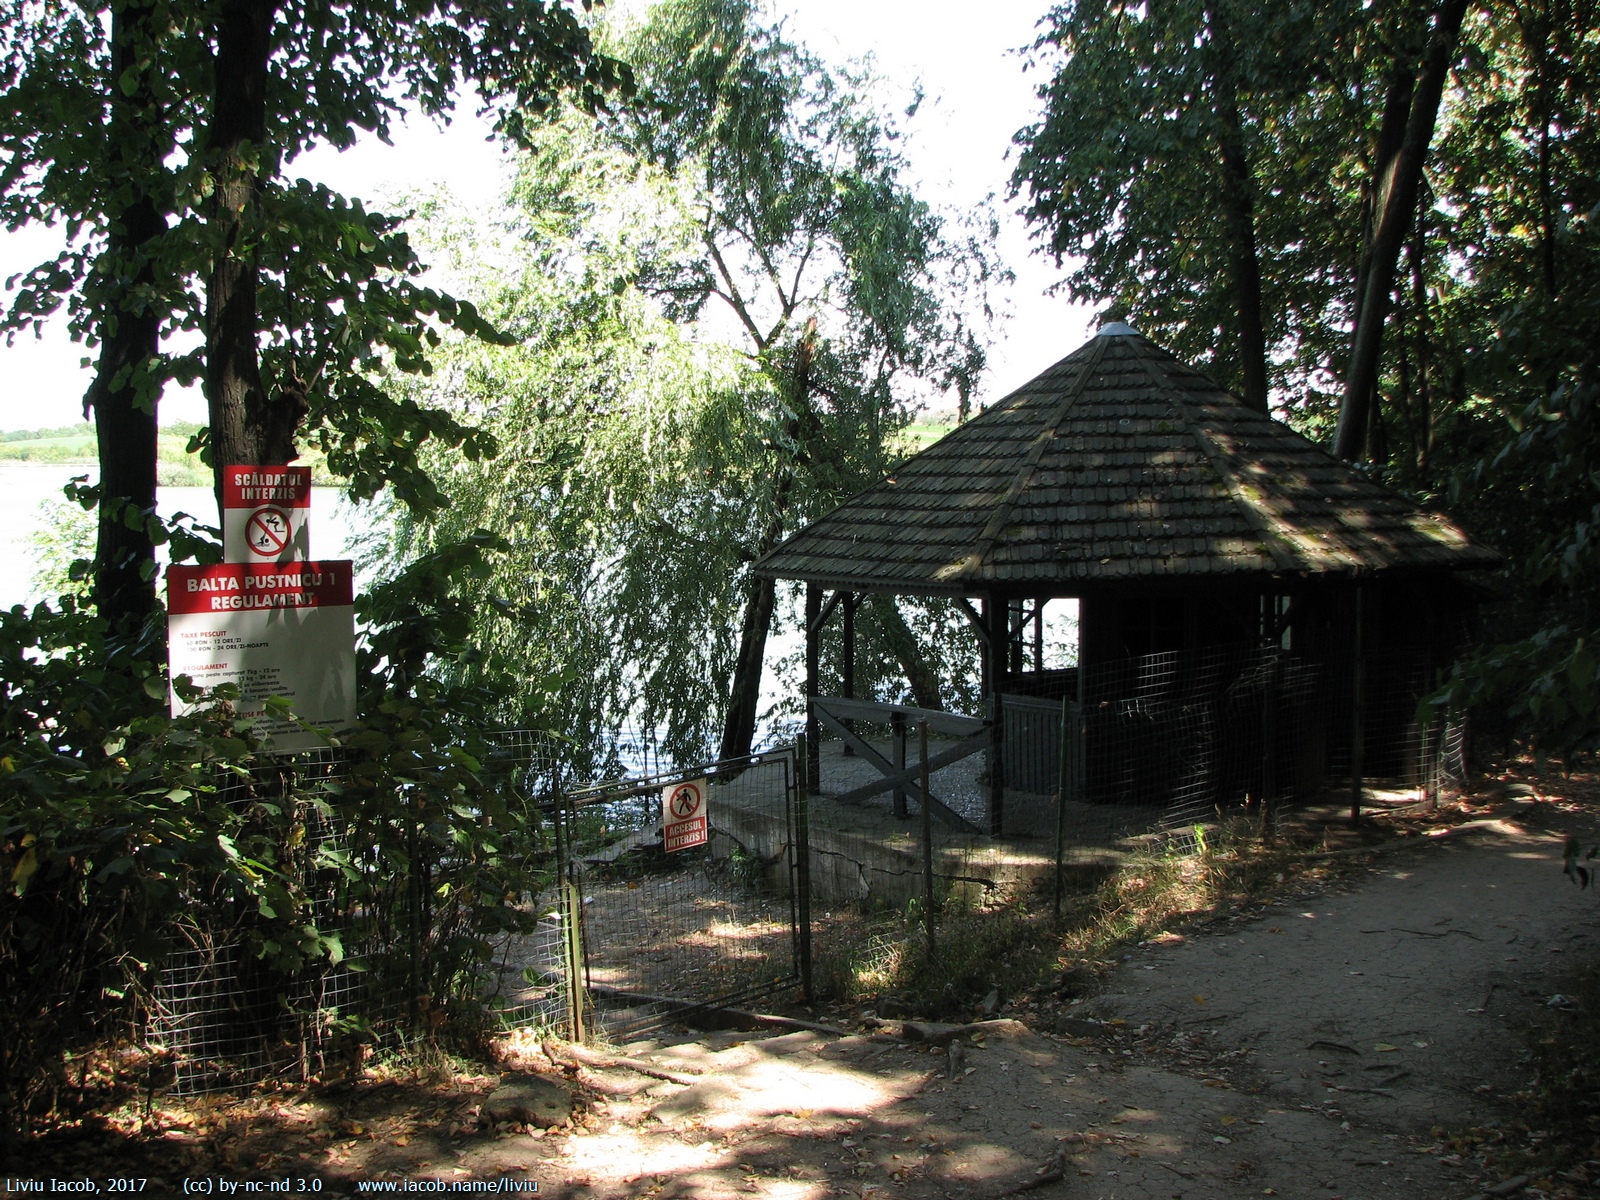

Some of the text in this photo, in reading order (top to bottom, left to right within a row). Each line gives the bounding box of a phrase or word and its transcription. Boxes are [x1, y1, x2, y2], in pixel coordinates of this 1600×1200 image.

[234, 472, 302, 486] SCĂLDATUL
[241, 487, 296, 500] INTERZIS
[187, 572, 335, 592] BALTA PUSTNICU 1
[211, 592, 314, 610] REGULAMENT
[200, 630, 227, 638] PESCUIT
[183, 663, 228, 671] REGULAMENT
[669, 819, 702, 837] ACCESUL
[668, 831, 700, 848] INTERZIS
